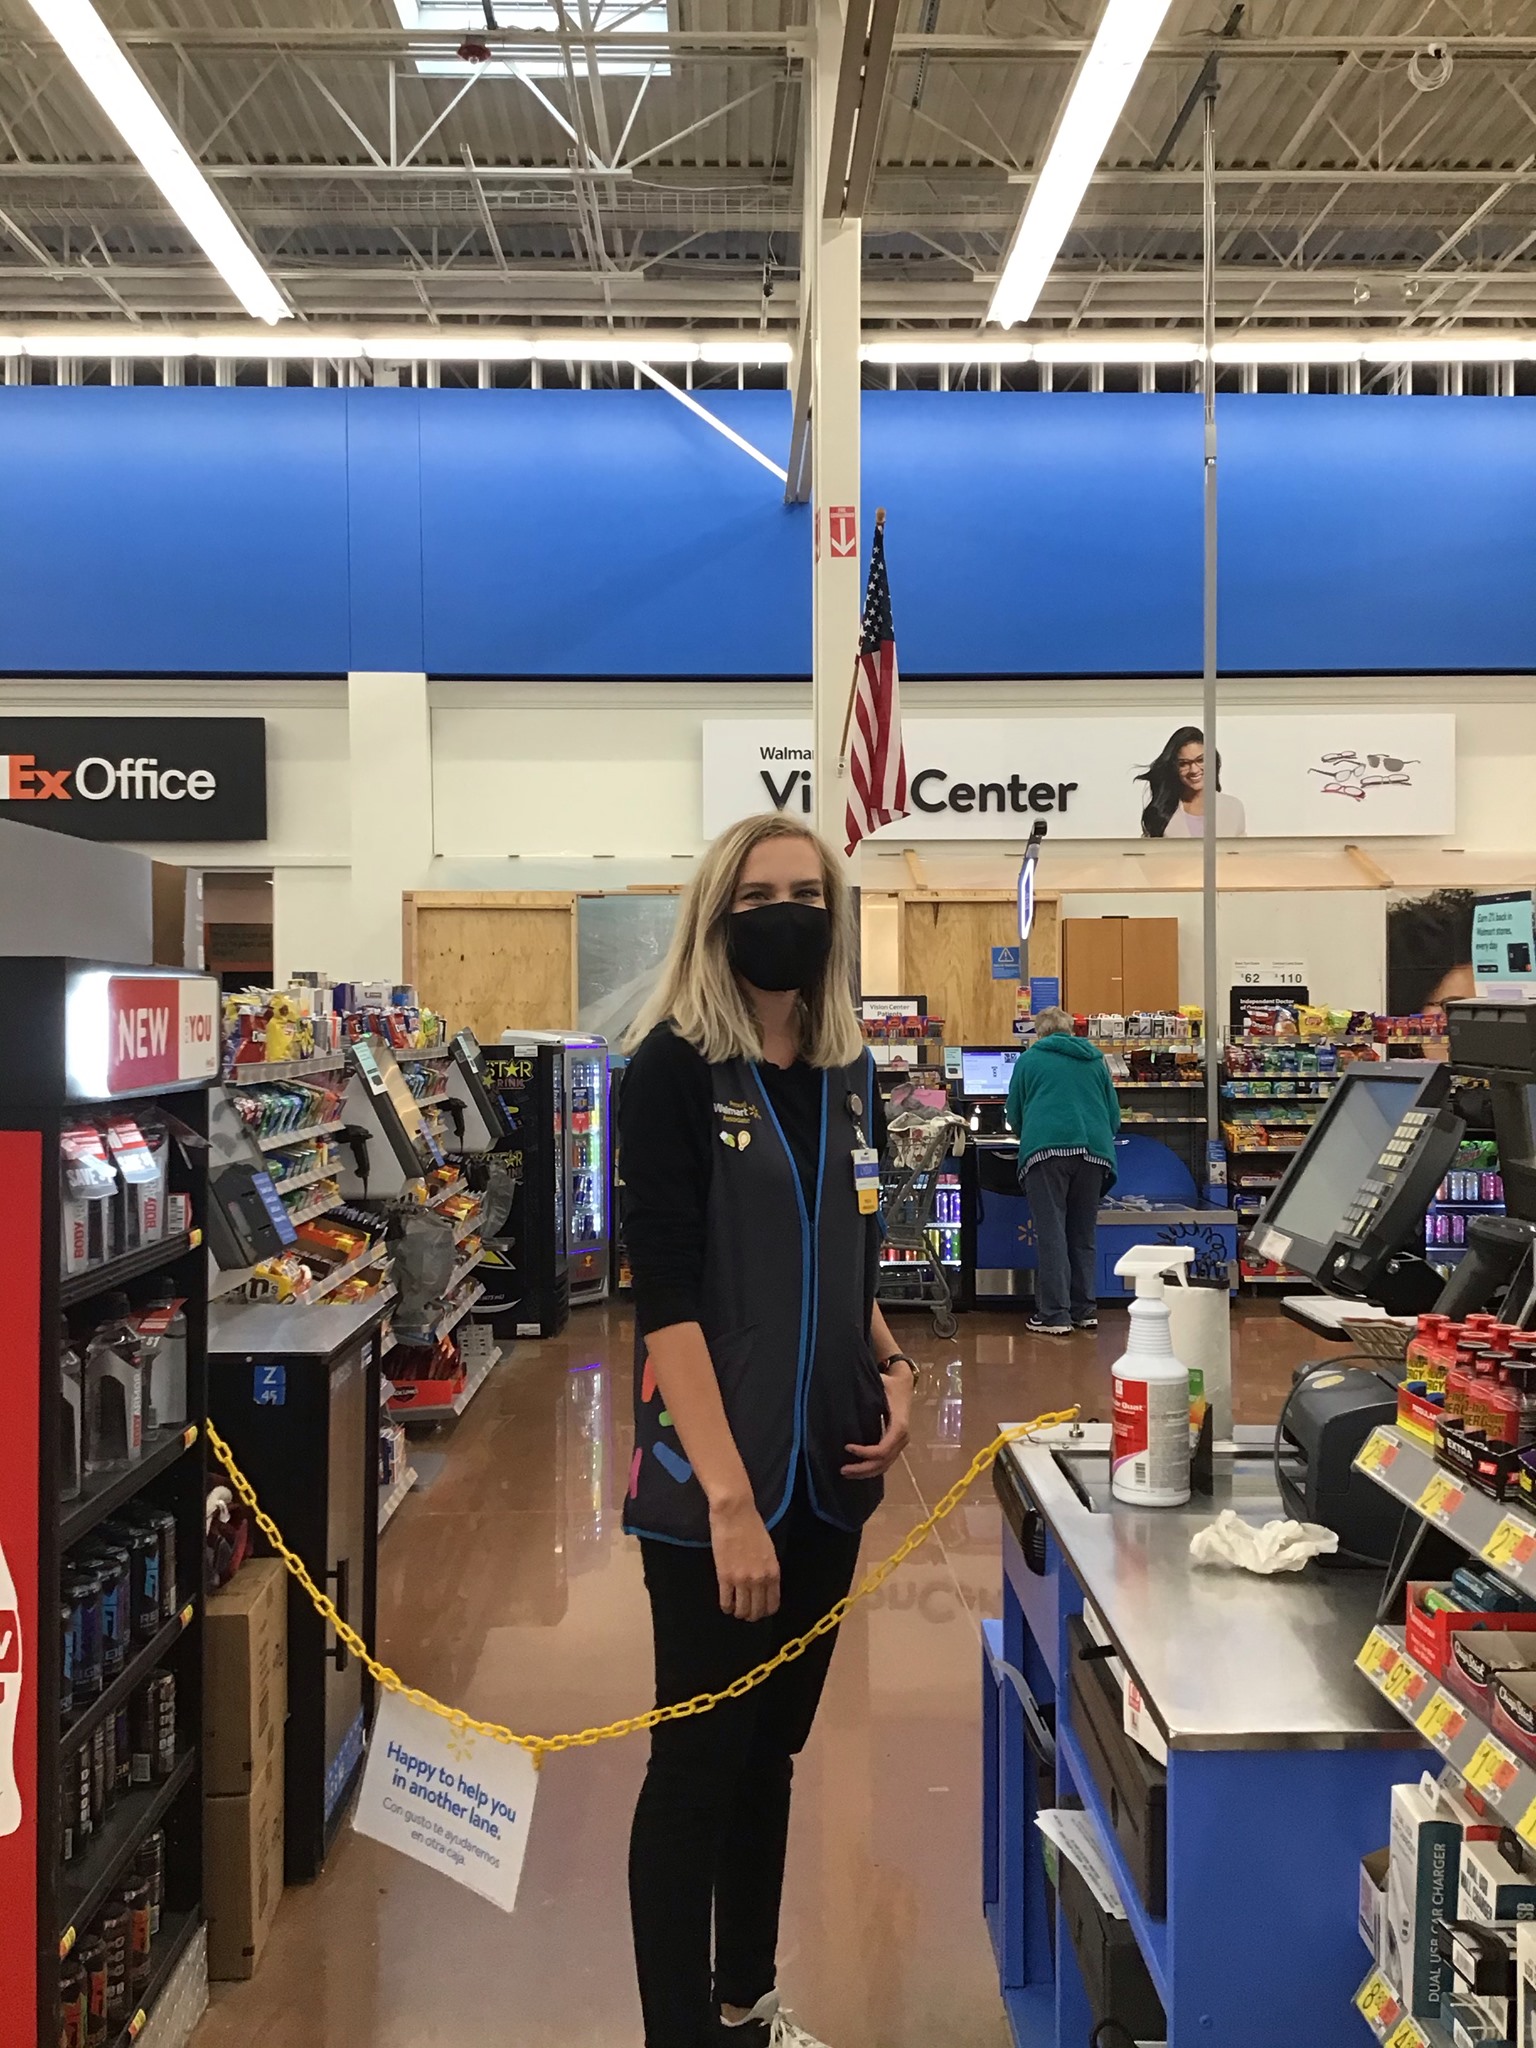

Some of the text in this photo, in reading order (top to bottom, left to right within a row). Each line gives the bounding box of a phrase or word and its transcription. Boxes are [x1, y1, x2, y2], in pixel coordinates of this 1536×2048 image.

[759, 746, 815, 762] Walma
[75, 756, 217, 801] Office
[910, 768, 1079, 814] Center
[189, 1014, 213, 1043] YOU
[877, 1010, 902, 1018] Patients
[118, 1007, 169, 1062] NEW
[496, 1078, 524, 1088] RINK
[713, 1103, 749, 1117] Walmart
[263, 1367, 277, 1384] Z
[1121, 1401, 1144, 1412] Quat
[1446, 1437, 1473, 1461] EXTRA
[387, 1741, 516, 1823] Happy to help you
[392, 1768, 502, 1840] in another lane.
[382, 1796, 500, 1869] Con gusto te ayudaremos
[411, 1829, 466, 1867] en otra caja.
[1433, 1843, 1446, 1906] CHARGER
[1517, 1903, 1535, 1920] SB
[1430, 1939, 1442, 1964] USB
[1428, 1968, 1441, 2003] DUAL
